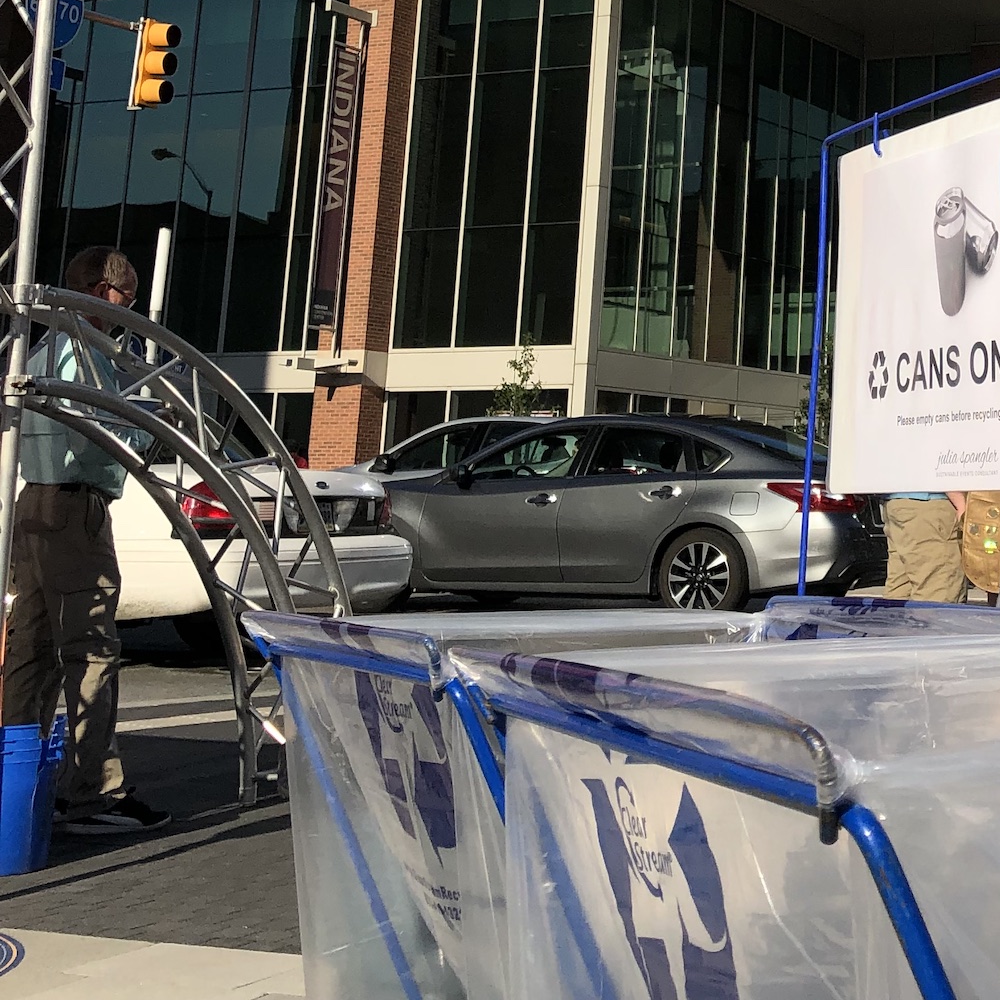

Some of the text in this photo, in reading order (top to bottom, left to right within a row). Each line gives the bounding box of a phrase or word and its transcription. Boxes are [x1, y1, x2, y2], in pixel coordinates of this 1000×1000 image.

[59, 1, 80, 24] 70
[324, 51, 358, 213] INDIANA
[896, 345, 961, 393] CANS
[897, 415, 914, 426] Please
[916, 412, 934, 426] empty
[935, 411, 950, 423] cans
[951, 410, 972, 422] before
[935, 447, 999, 470] julia spangler
[621, 806, 647, 839] Clear
